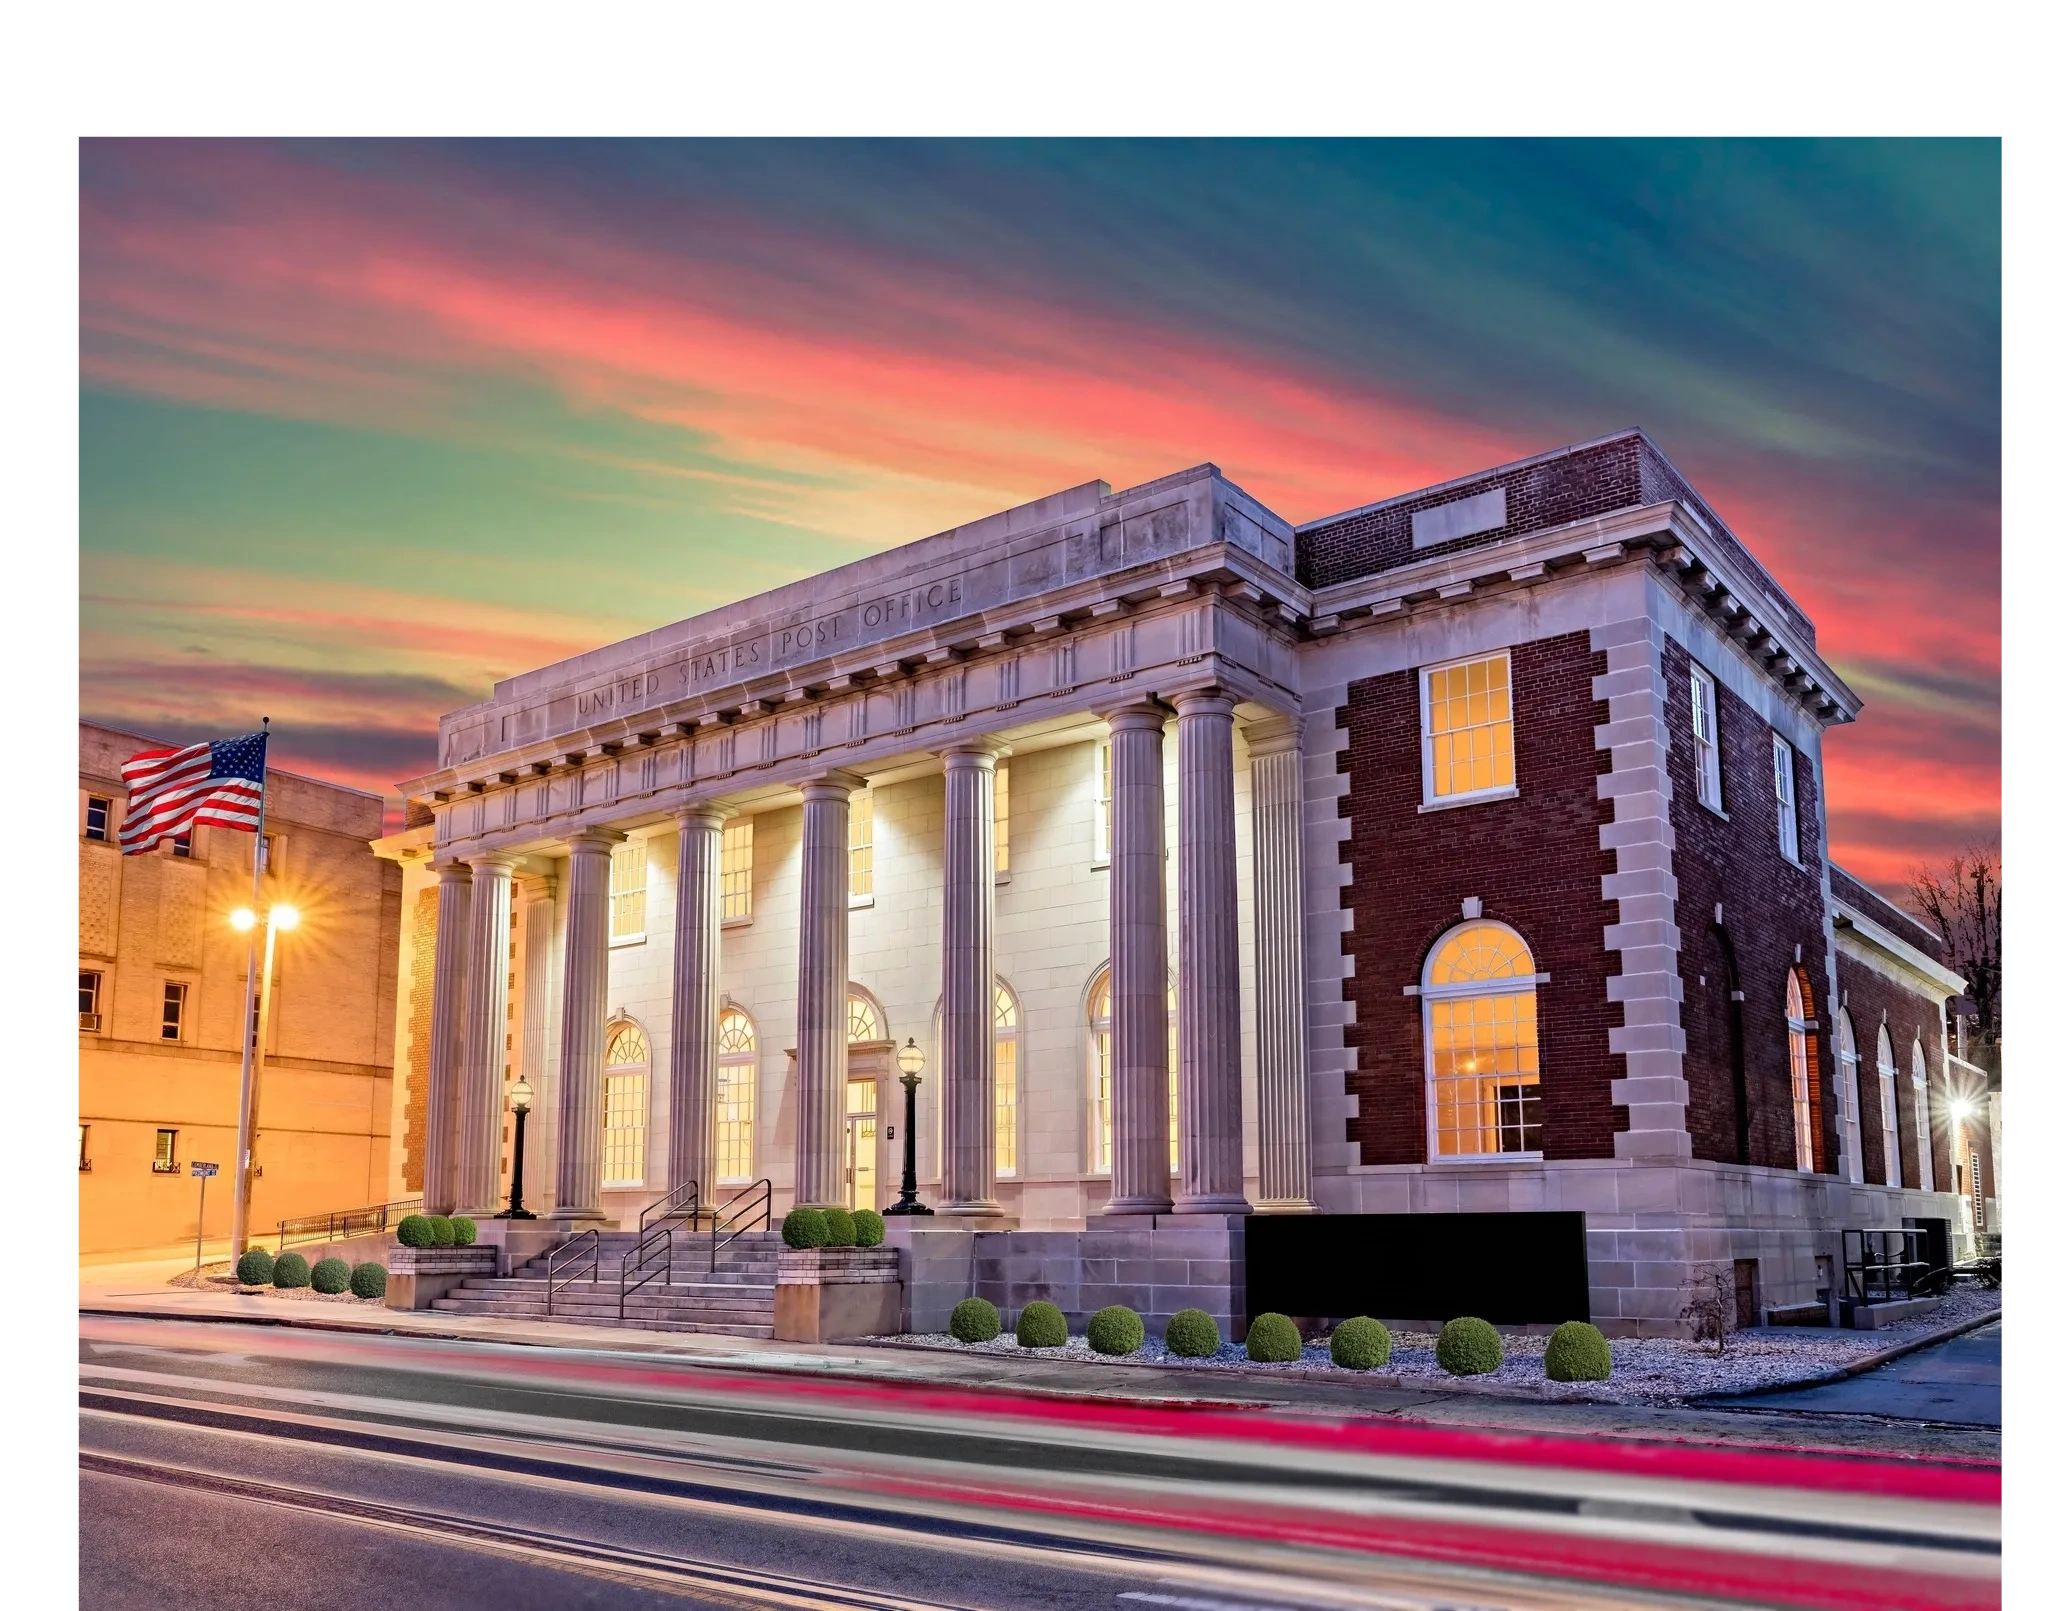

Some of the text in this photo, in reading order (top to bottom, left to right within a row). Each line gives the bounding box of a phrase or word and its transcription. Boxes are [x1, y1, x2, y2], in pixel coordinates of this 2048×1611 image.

[578, 579, 962, 715] UNITED STATES POST OFFICE
